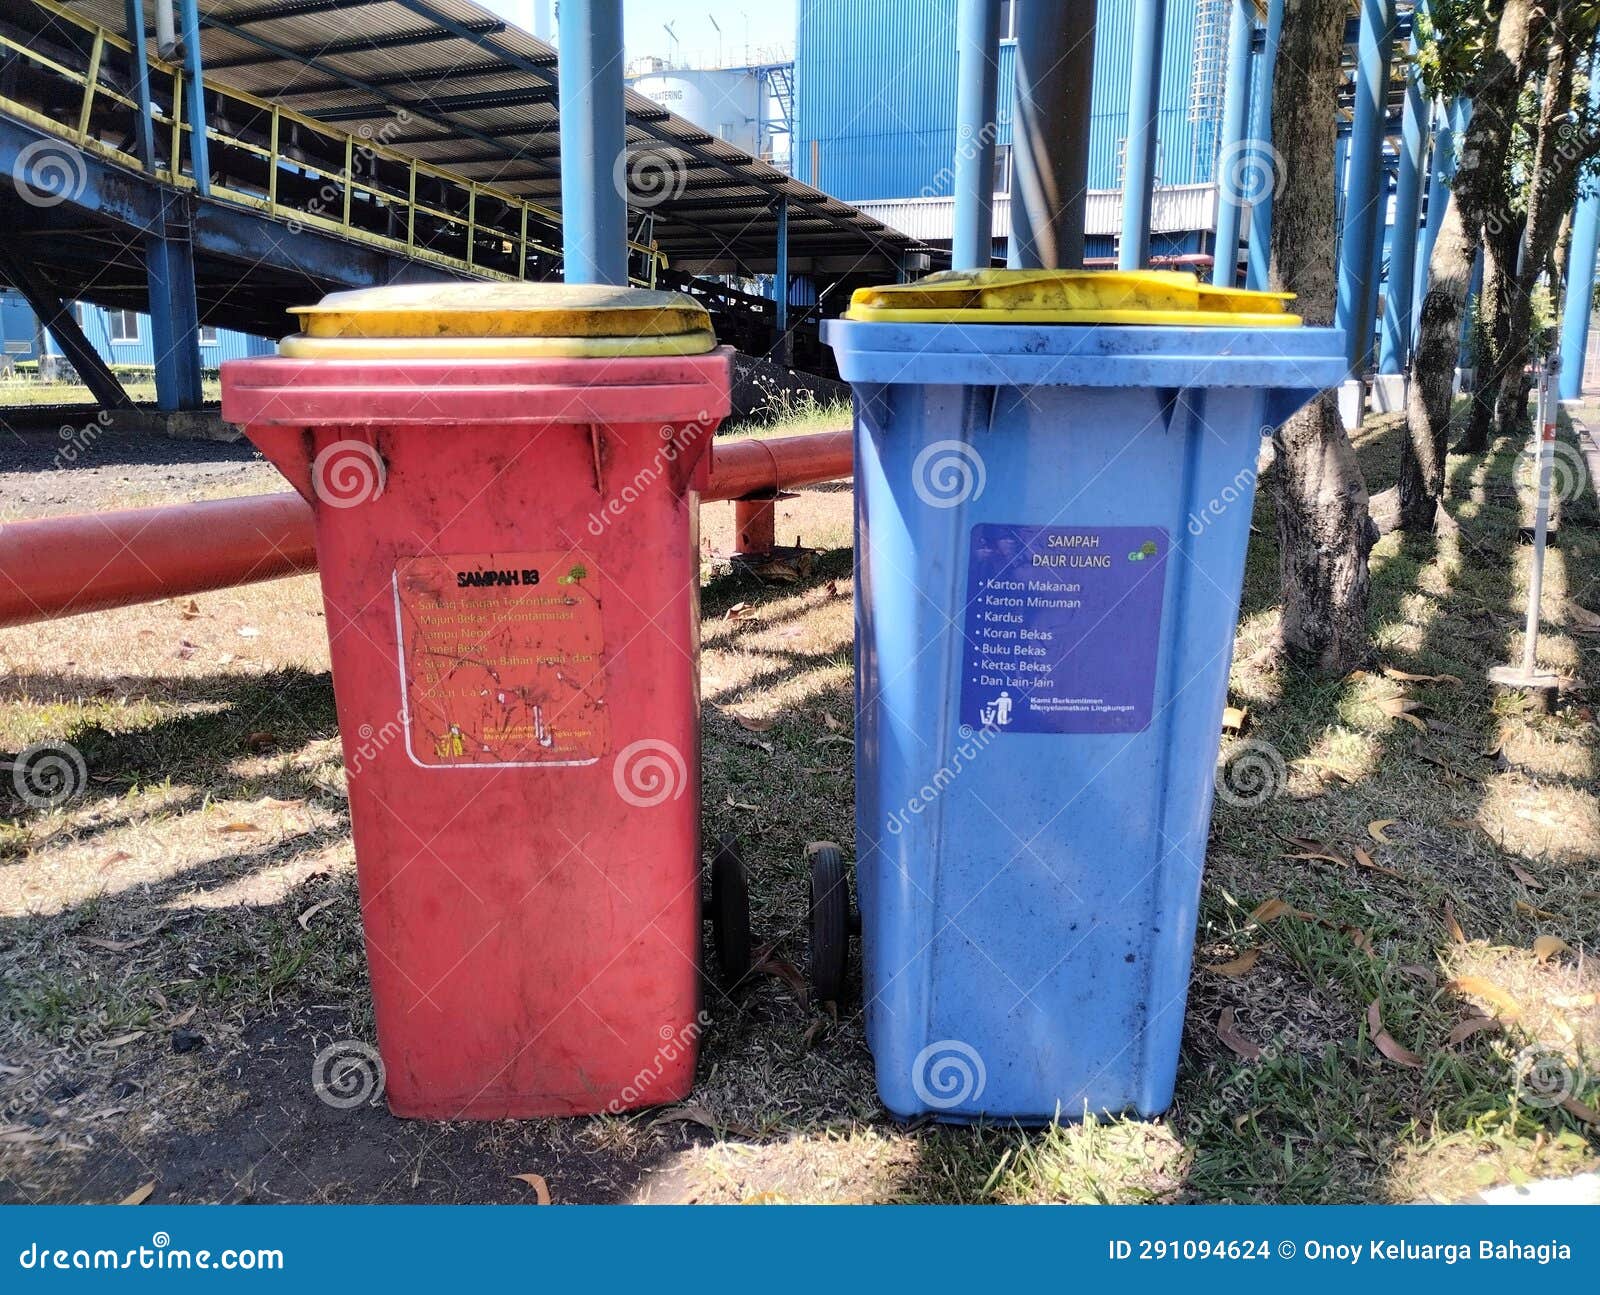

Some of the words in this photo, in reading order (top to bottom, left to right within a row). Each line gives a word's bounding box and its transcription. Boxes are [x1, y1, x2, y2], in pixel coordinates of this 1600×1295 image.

[646, 89, 683, 101] EWATERING
[1047, 535, 1100, 548] SAMPAH
[1032, 553, 1066, 567] DAUR
[1070, 555, 1111, 568] ULANG
[457, 570, 519, 587] SAMPAH
[986, 578, 1025, 591] Karton
[1028, 580, 1081, 593] Makanan
[985, 595, 1023, 607] Karton
[1027, 596, 1081, 609] Minuman
[984, 611, 1024, 624] Kardus
[983, 627, 1017, 640] Koran
[1020, 629, 1053, 641] Bekas
[982, 643, 1011, 655] Buku
[1014, 644, 1047, 657] Bekas
[981, 659, 1016, 671] Kertas
[1019, 661, 1052, 673] Bekas
[980, 674, 1003, 686] Dan
[1007, 676, 1054, 688] Lain-lain
[1030, 697, 1051, 705] Kami
[1030, 704, 1090, 713] Menyelamatkan
[1091, 704, 1135, 713] Lingkungan
